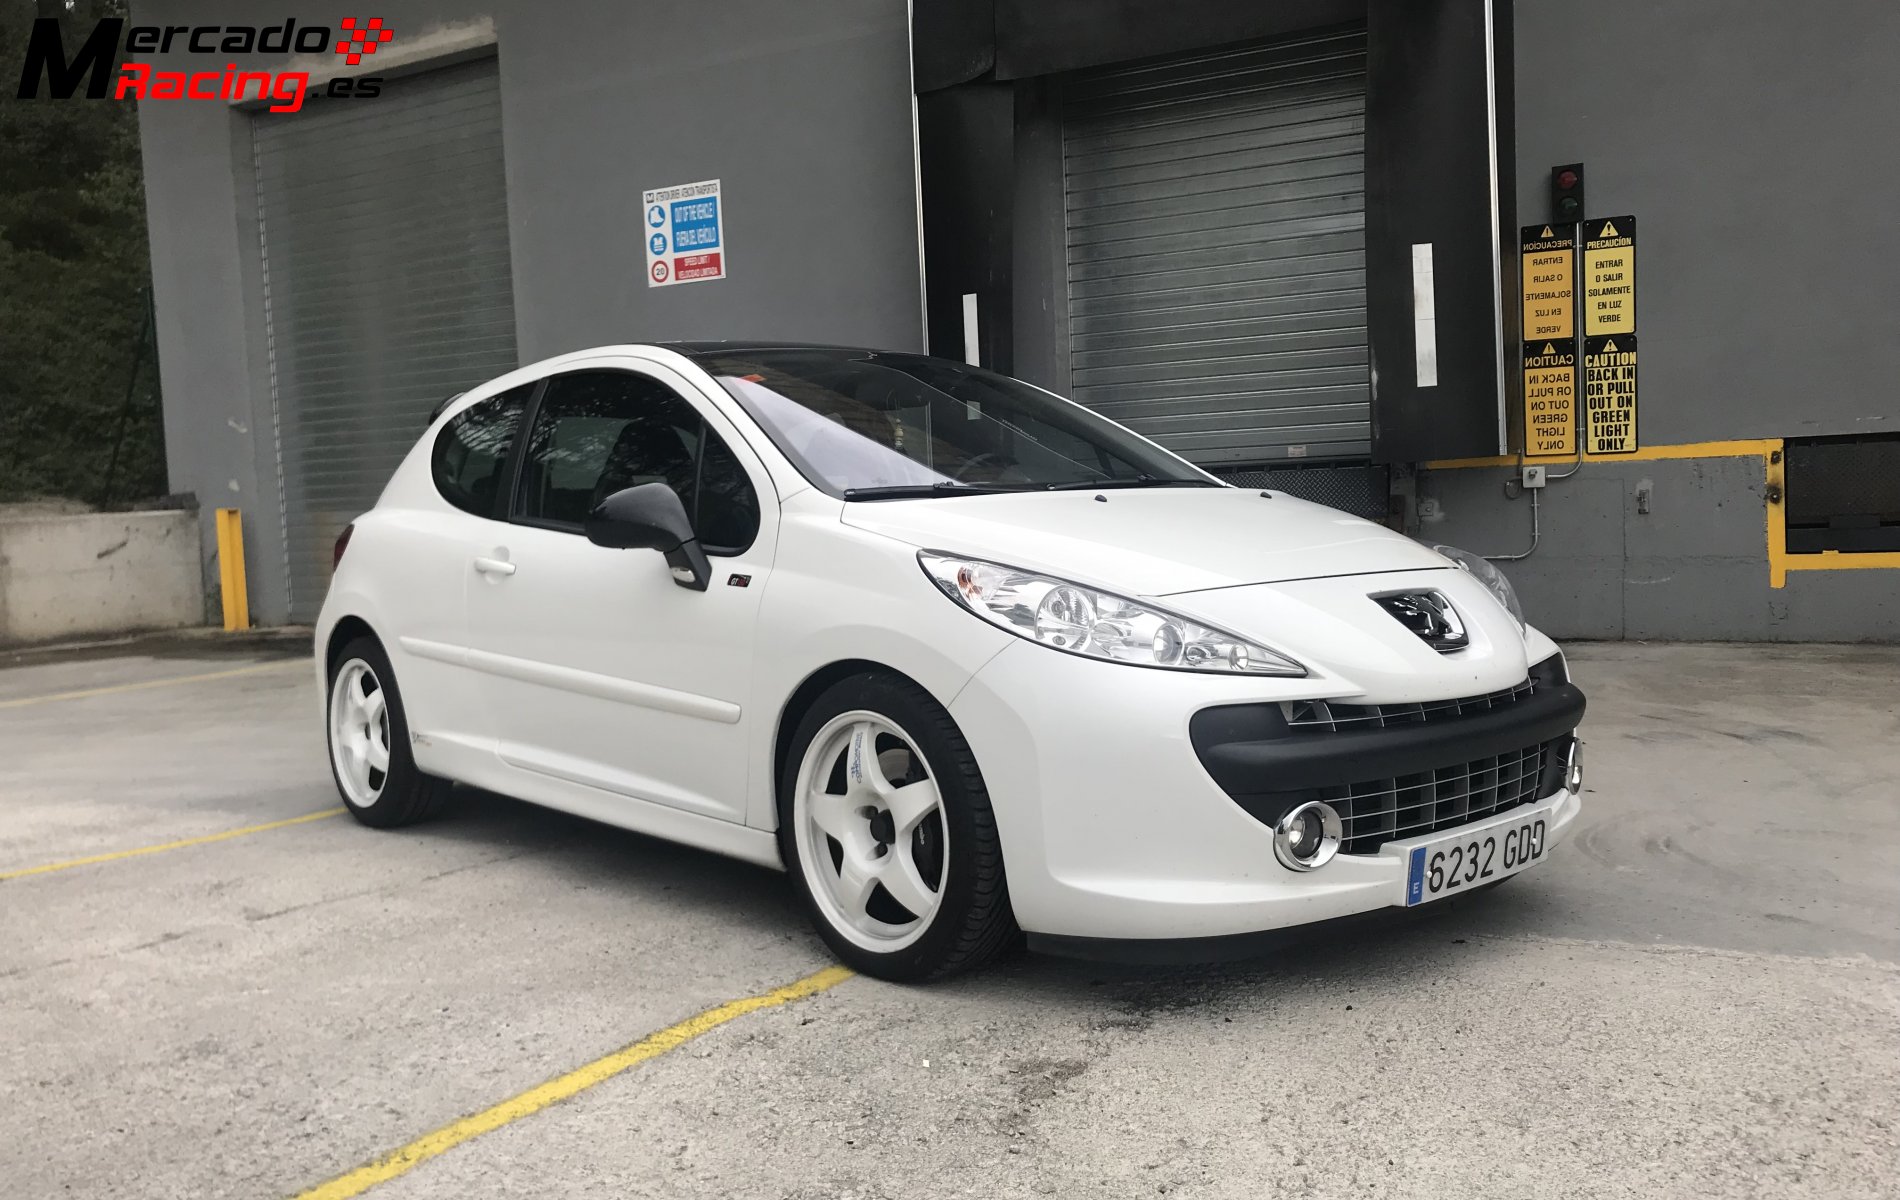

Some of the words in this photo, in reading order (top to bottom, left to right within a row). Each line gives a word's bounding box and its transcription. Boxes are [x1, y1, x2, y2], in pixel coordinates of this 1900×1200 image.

[1595, 259, 1623, 269] ENTRAR
[656, 267, 665, 276] 20
[1596, 274, 1600, 282] O
[1603, 273, 1623, 282] SALIR
[1588, 286, 1631, 297] SOLAMENTE
[1598, 302, 1607, 310] EN
[1609, 300, 1622, 308] LUZ
[1598, 314, 1621, 323] VERDE
[1585, 352, 1636, 368] CAUTION
[1588, 368, 1619, 382] BACK
[1622, 367, 1633, 380] IN
[1588, 384, 1603, 396] OR
[1608, 382, 1634, 394] PULL
[1590, 396, 1612, 410] OUT
[1617, 396, 1632, 408] ON
[1592, 410, 1630, 424] GREEN
[1594, 424, 1630, 438] LIGHT
[1598, 438, 1626, 450] ONLY
[1429, 836, 1496, 893] 6232
[1504, 819, 1546, 869] GDD
[1413, 882, 1420, 894] E
